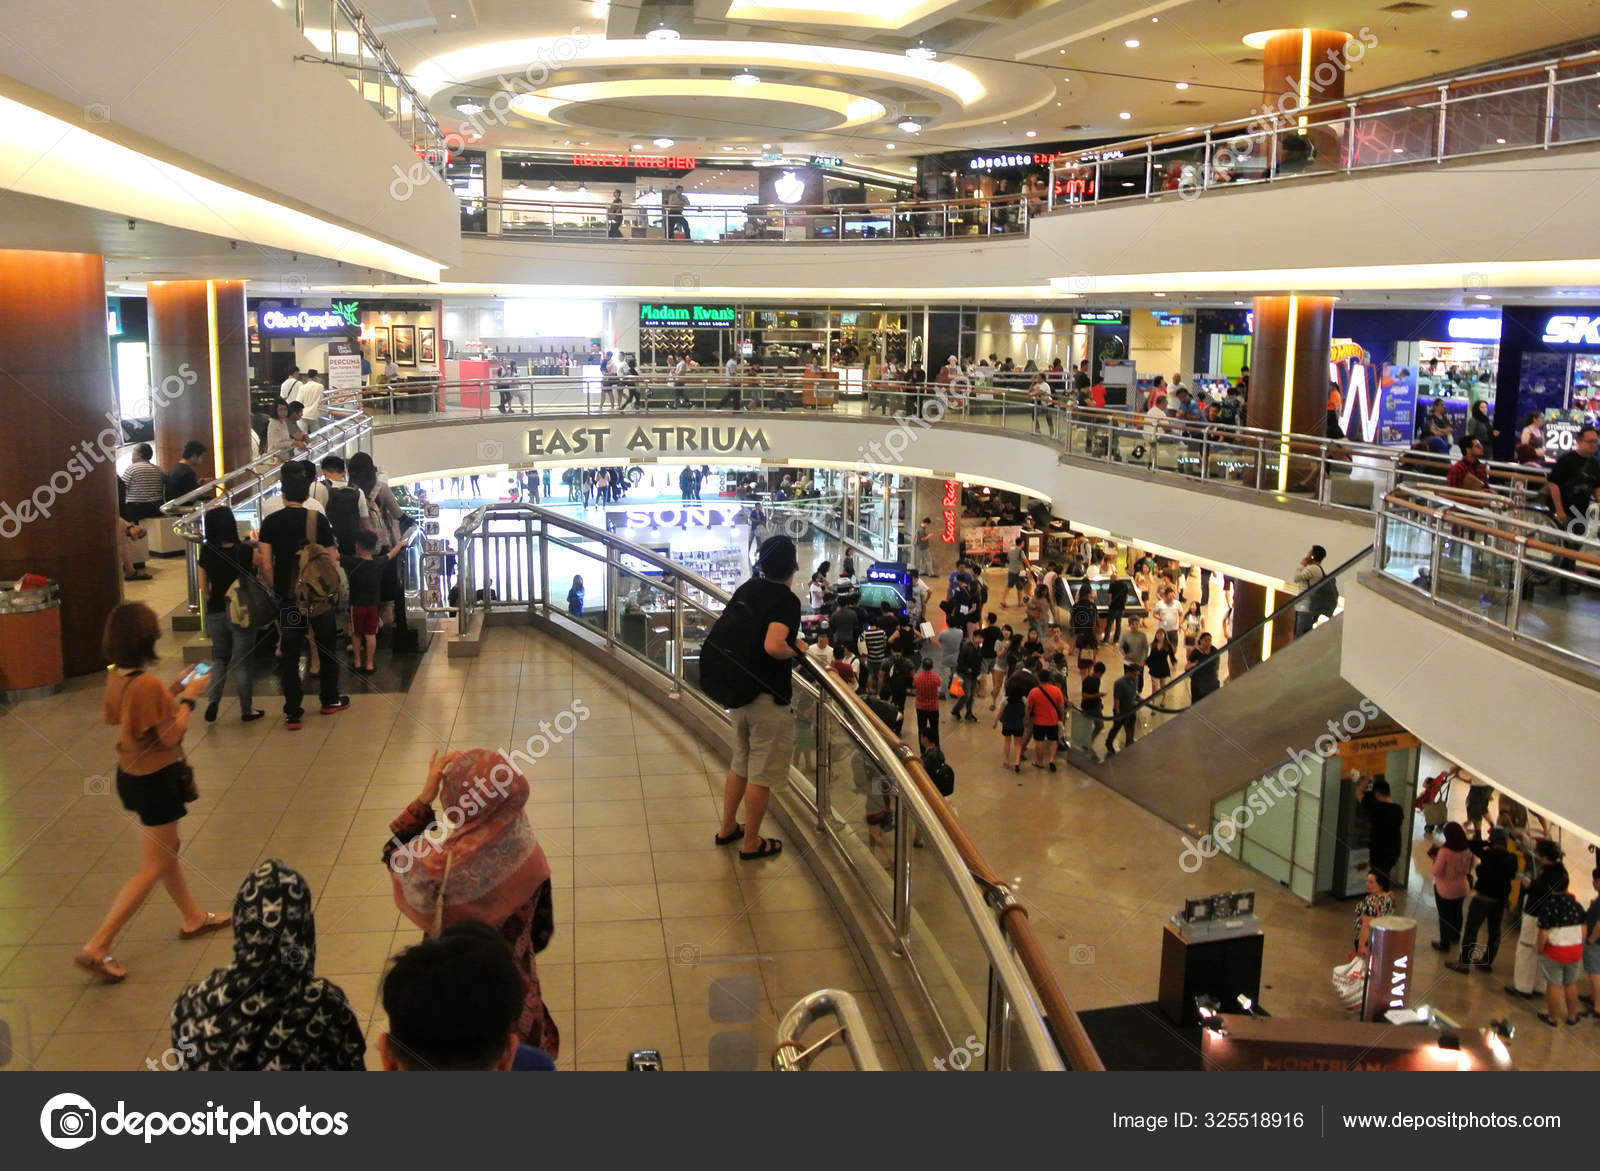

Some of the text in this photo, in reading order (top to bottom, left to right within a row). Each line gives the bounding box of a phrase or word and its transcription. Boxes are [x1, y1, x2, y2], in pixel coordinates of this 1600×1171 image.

[634, 155, 696, 170] KITCHEN
[970, 154, 1031, 169] absolute
[641, 305, 735, 320] Madam Kwan's
[263, 311, 344, 332] Olive Garden
[527, 425, 771, 456] EAST ATRIUM
[625, 506, 741, 529] SONY
[1360, 739, 1399, 751] Maybank
